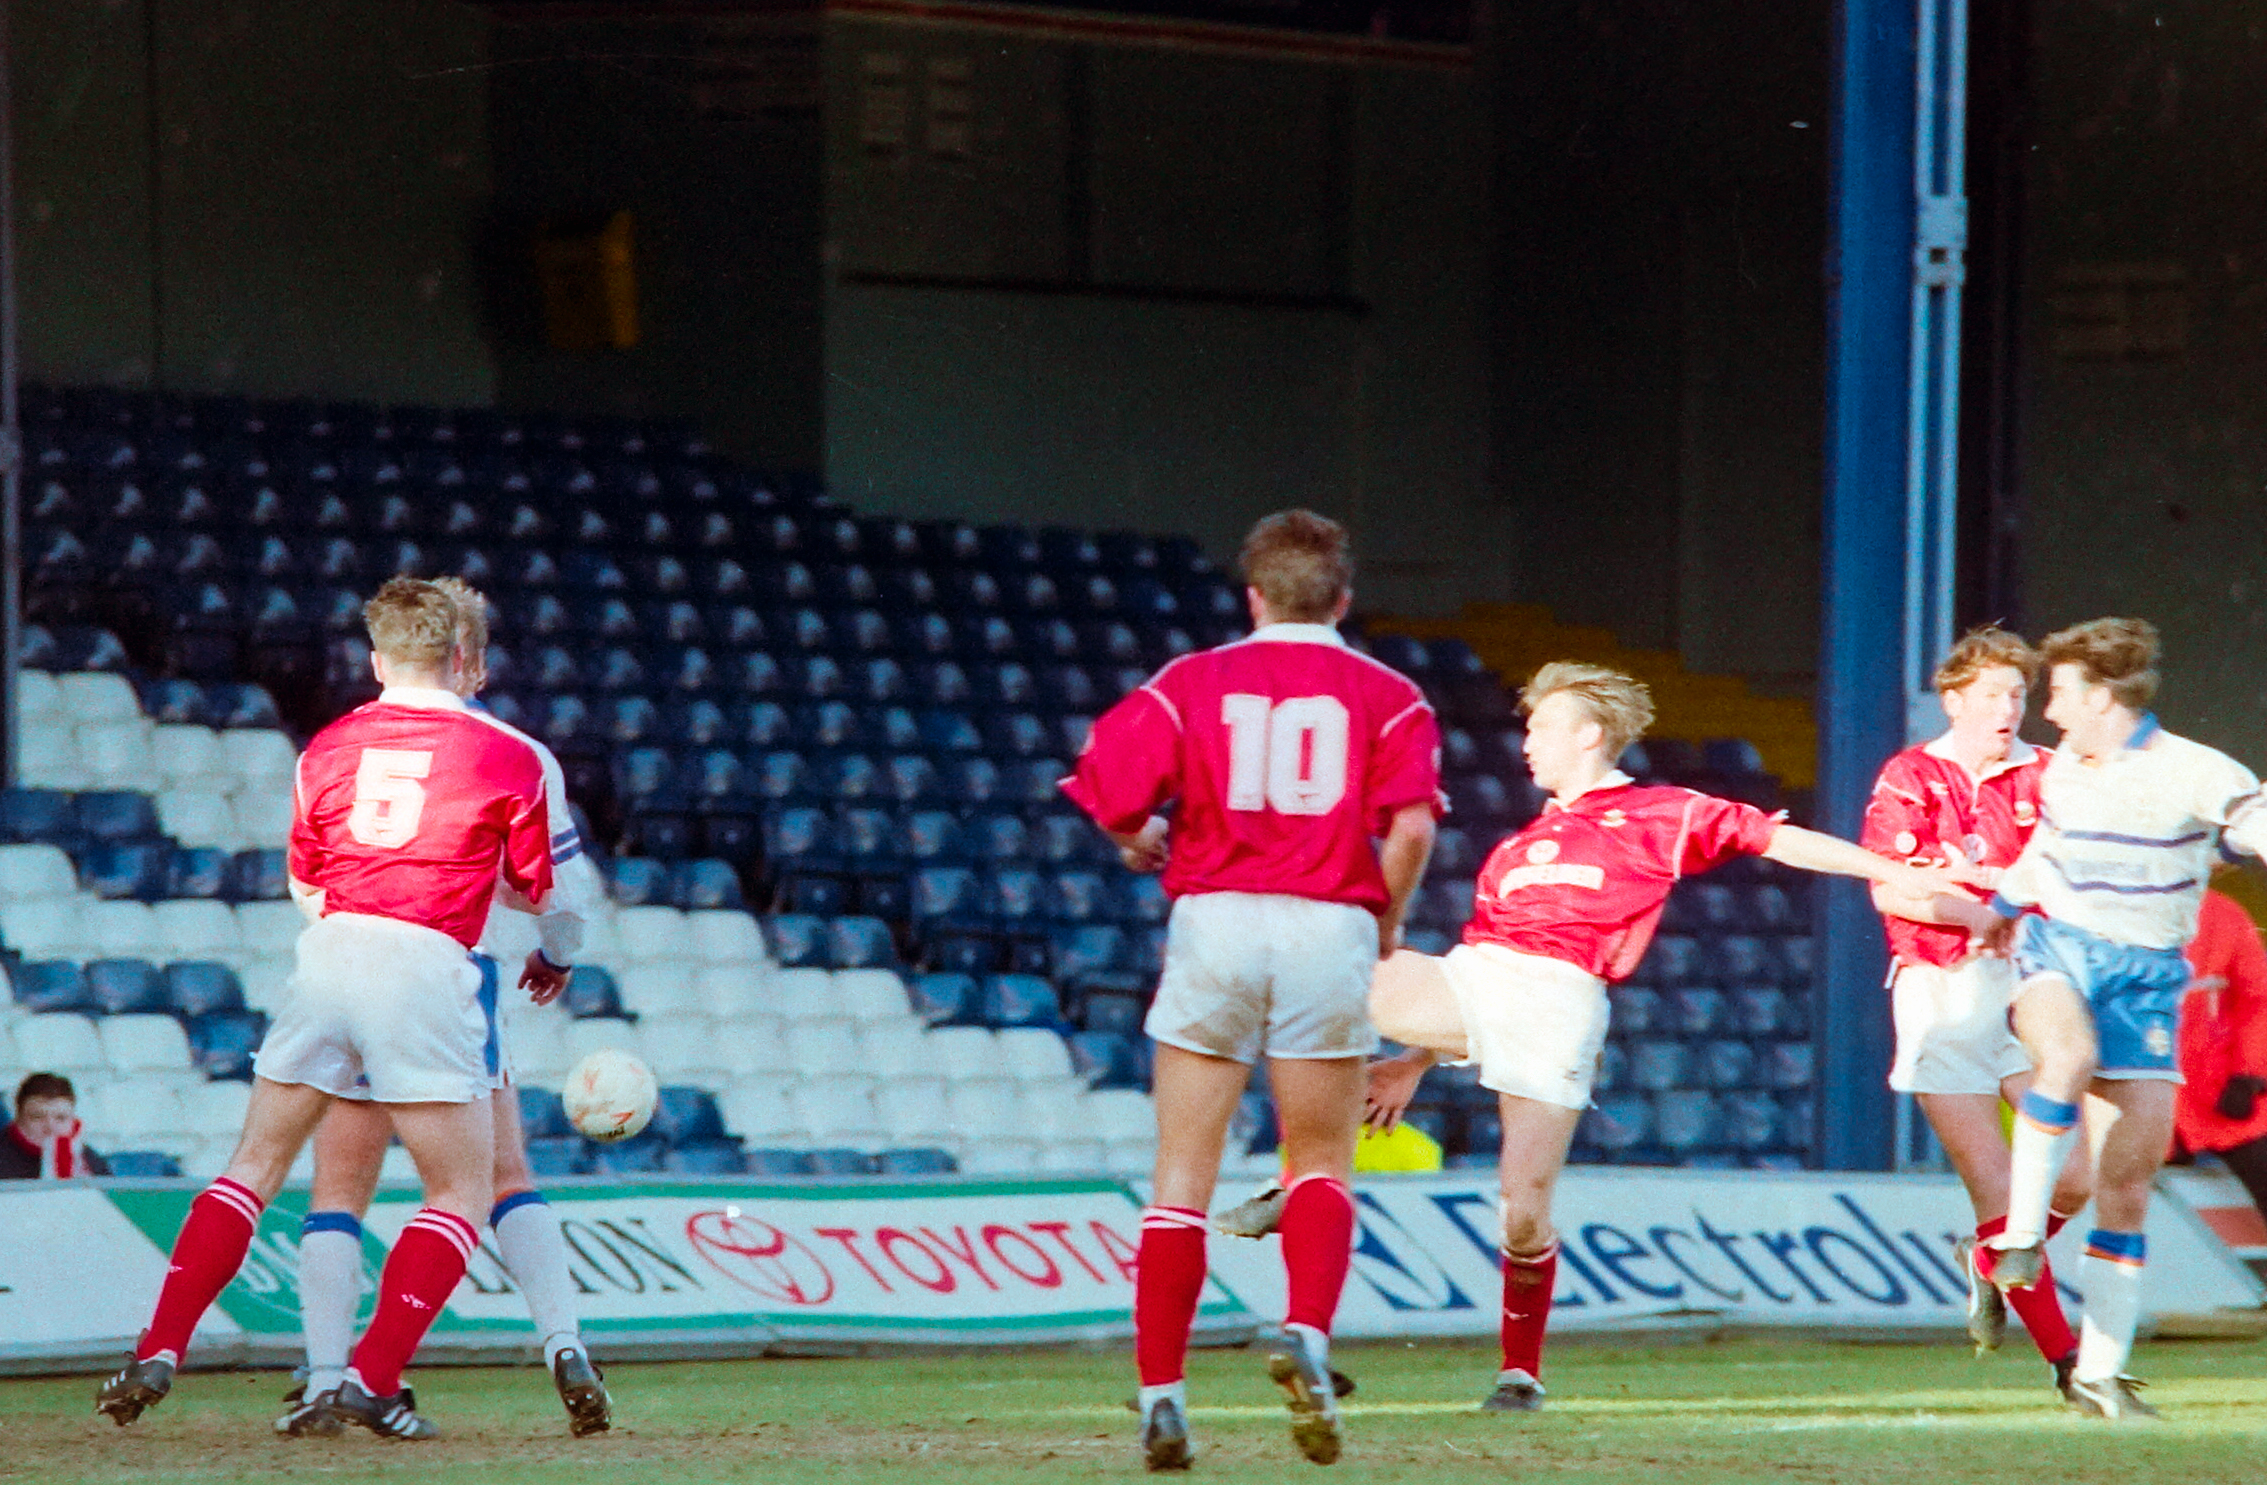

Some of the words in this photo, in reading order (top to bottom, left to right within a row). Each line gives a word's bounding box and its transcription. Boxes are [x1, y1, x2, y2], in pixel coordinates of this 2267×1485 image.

[348, 748, 433, 848] 5
[1221, 693, 1349, 816] 10
[813, 1220, 1139, 1293] TOYOTA
